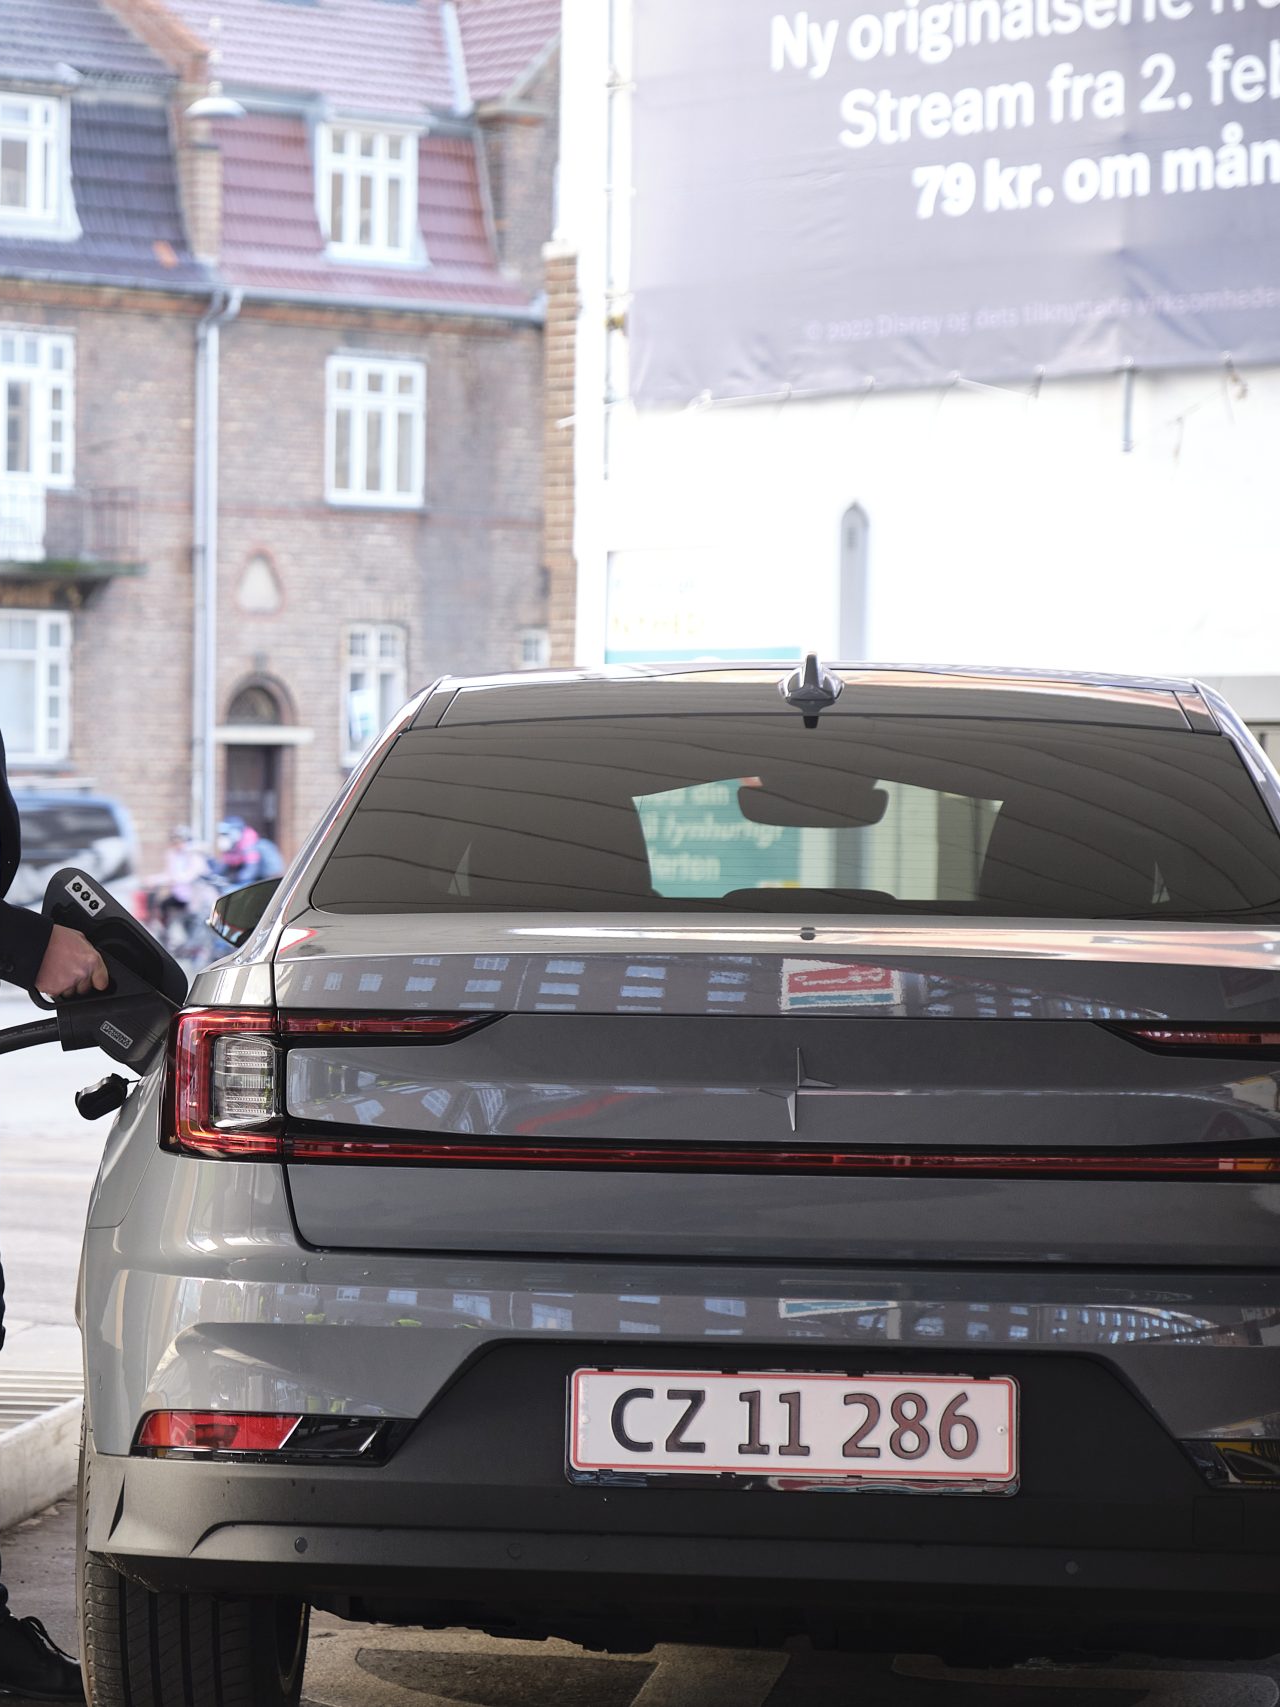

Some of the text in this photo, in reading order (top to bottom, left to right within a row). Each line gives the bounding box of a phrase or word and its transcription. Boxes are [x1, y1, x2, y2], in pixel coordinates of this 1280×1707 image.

[770, 11, 839, 79] Ny
[837, 80, 1035, 149] Stream
[1046, 62, 1125, 125] fra
[1138, 52, 1193, 114] 2.
[911, 120, 1280, 220] 79 kr. om mån
[610, 1387, 979, 1460] CZ 11 286
